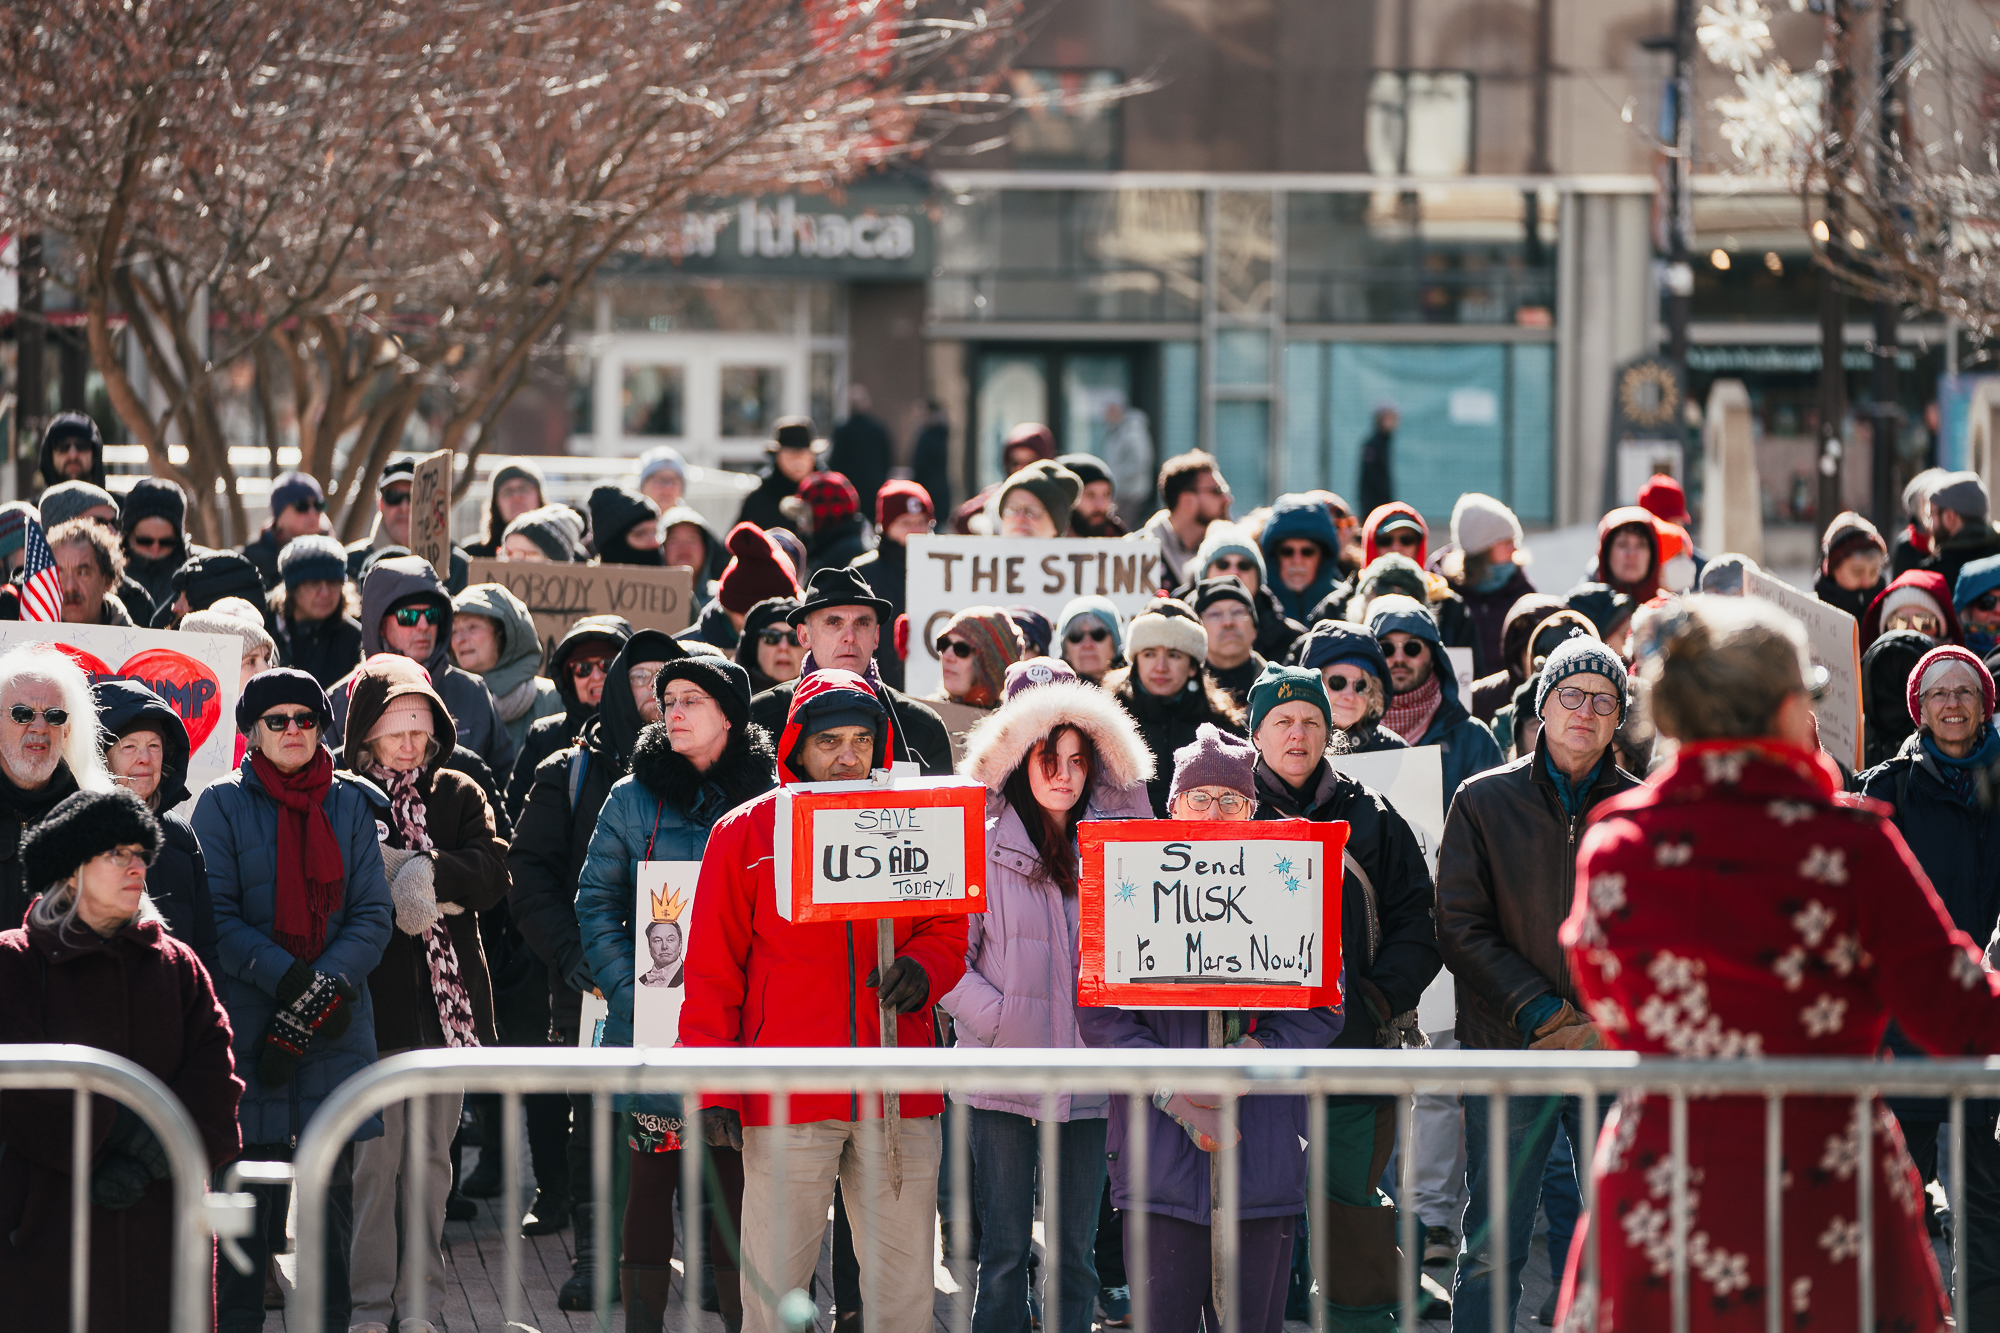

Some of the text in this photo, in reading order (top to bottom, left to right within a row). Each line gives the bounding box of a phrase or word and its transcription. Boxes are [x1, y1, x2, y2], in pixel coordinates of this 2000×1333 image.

[738, 196, 915, 259] Ithaca
[486, 570, 678, 615] NOBODY VOTED
[928, 552, 1158, 596] THE STINK
[1031, 668, 1049, 677] UP
[855, 808, 921, 830] SAVE
[1160, 843, 1245, 876] Send
[1153, 879, 1253, 925] MUSK
[1186, 931, 1242, 976] Mars
